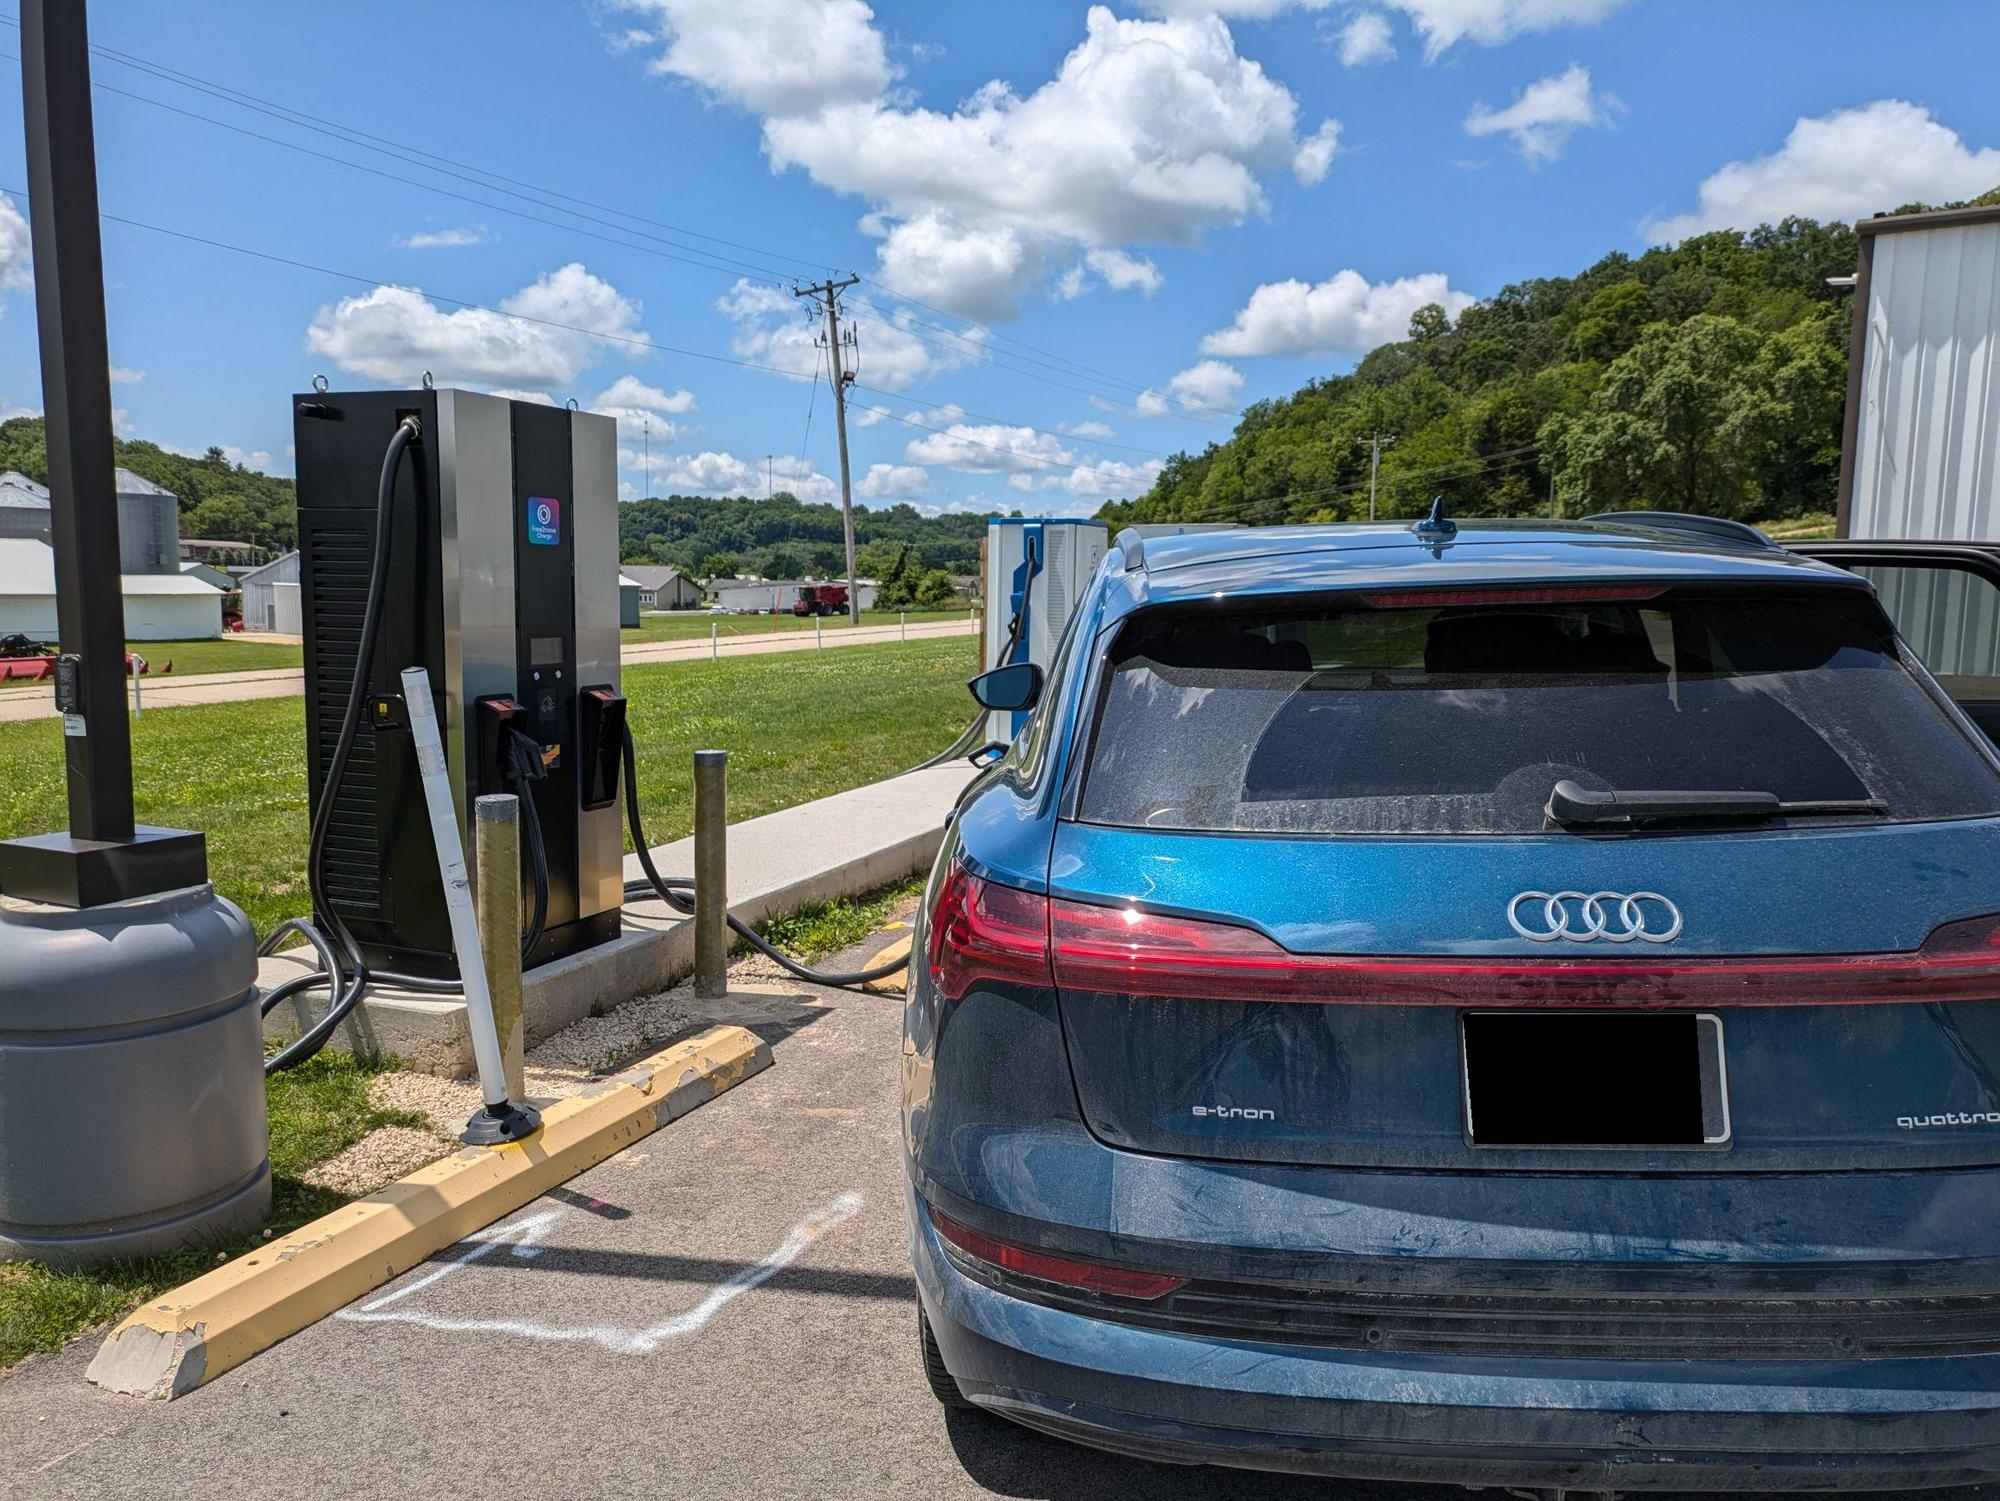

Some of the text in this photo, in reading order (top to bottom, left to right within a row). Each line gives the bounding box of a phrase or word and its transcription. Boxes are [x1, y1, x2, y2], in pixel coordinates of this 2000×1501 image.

[536, 532, 552, 541] Charge
[1192, 1105, 1275, 1120] e-tron
[1896, 1112, 2000, 1129] quattro
